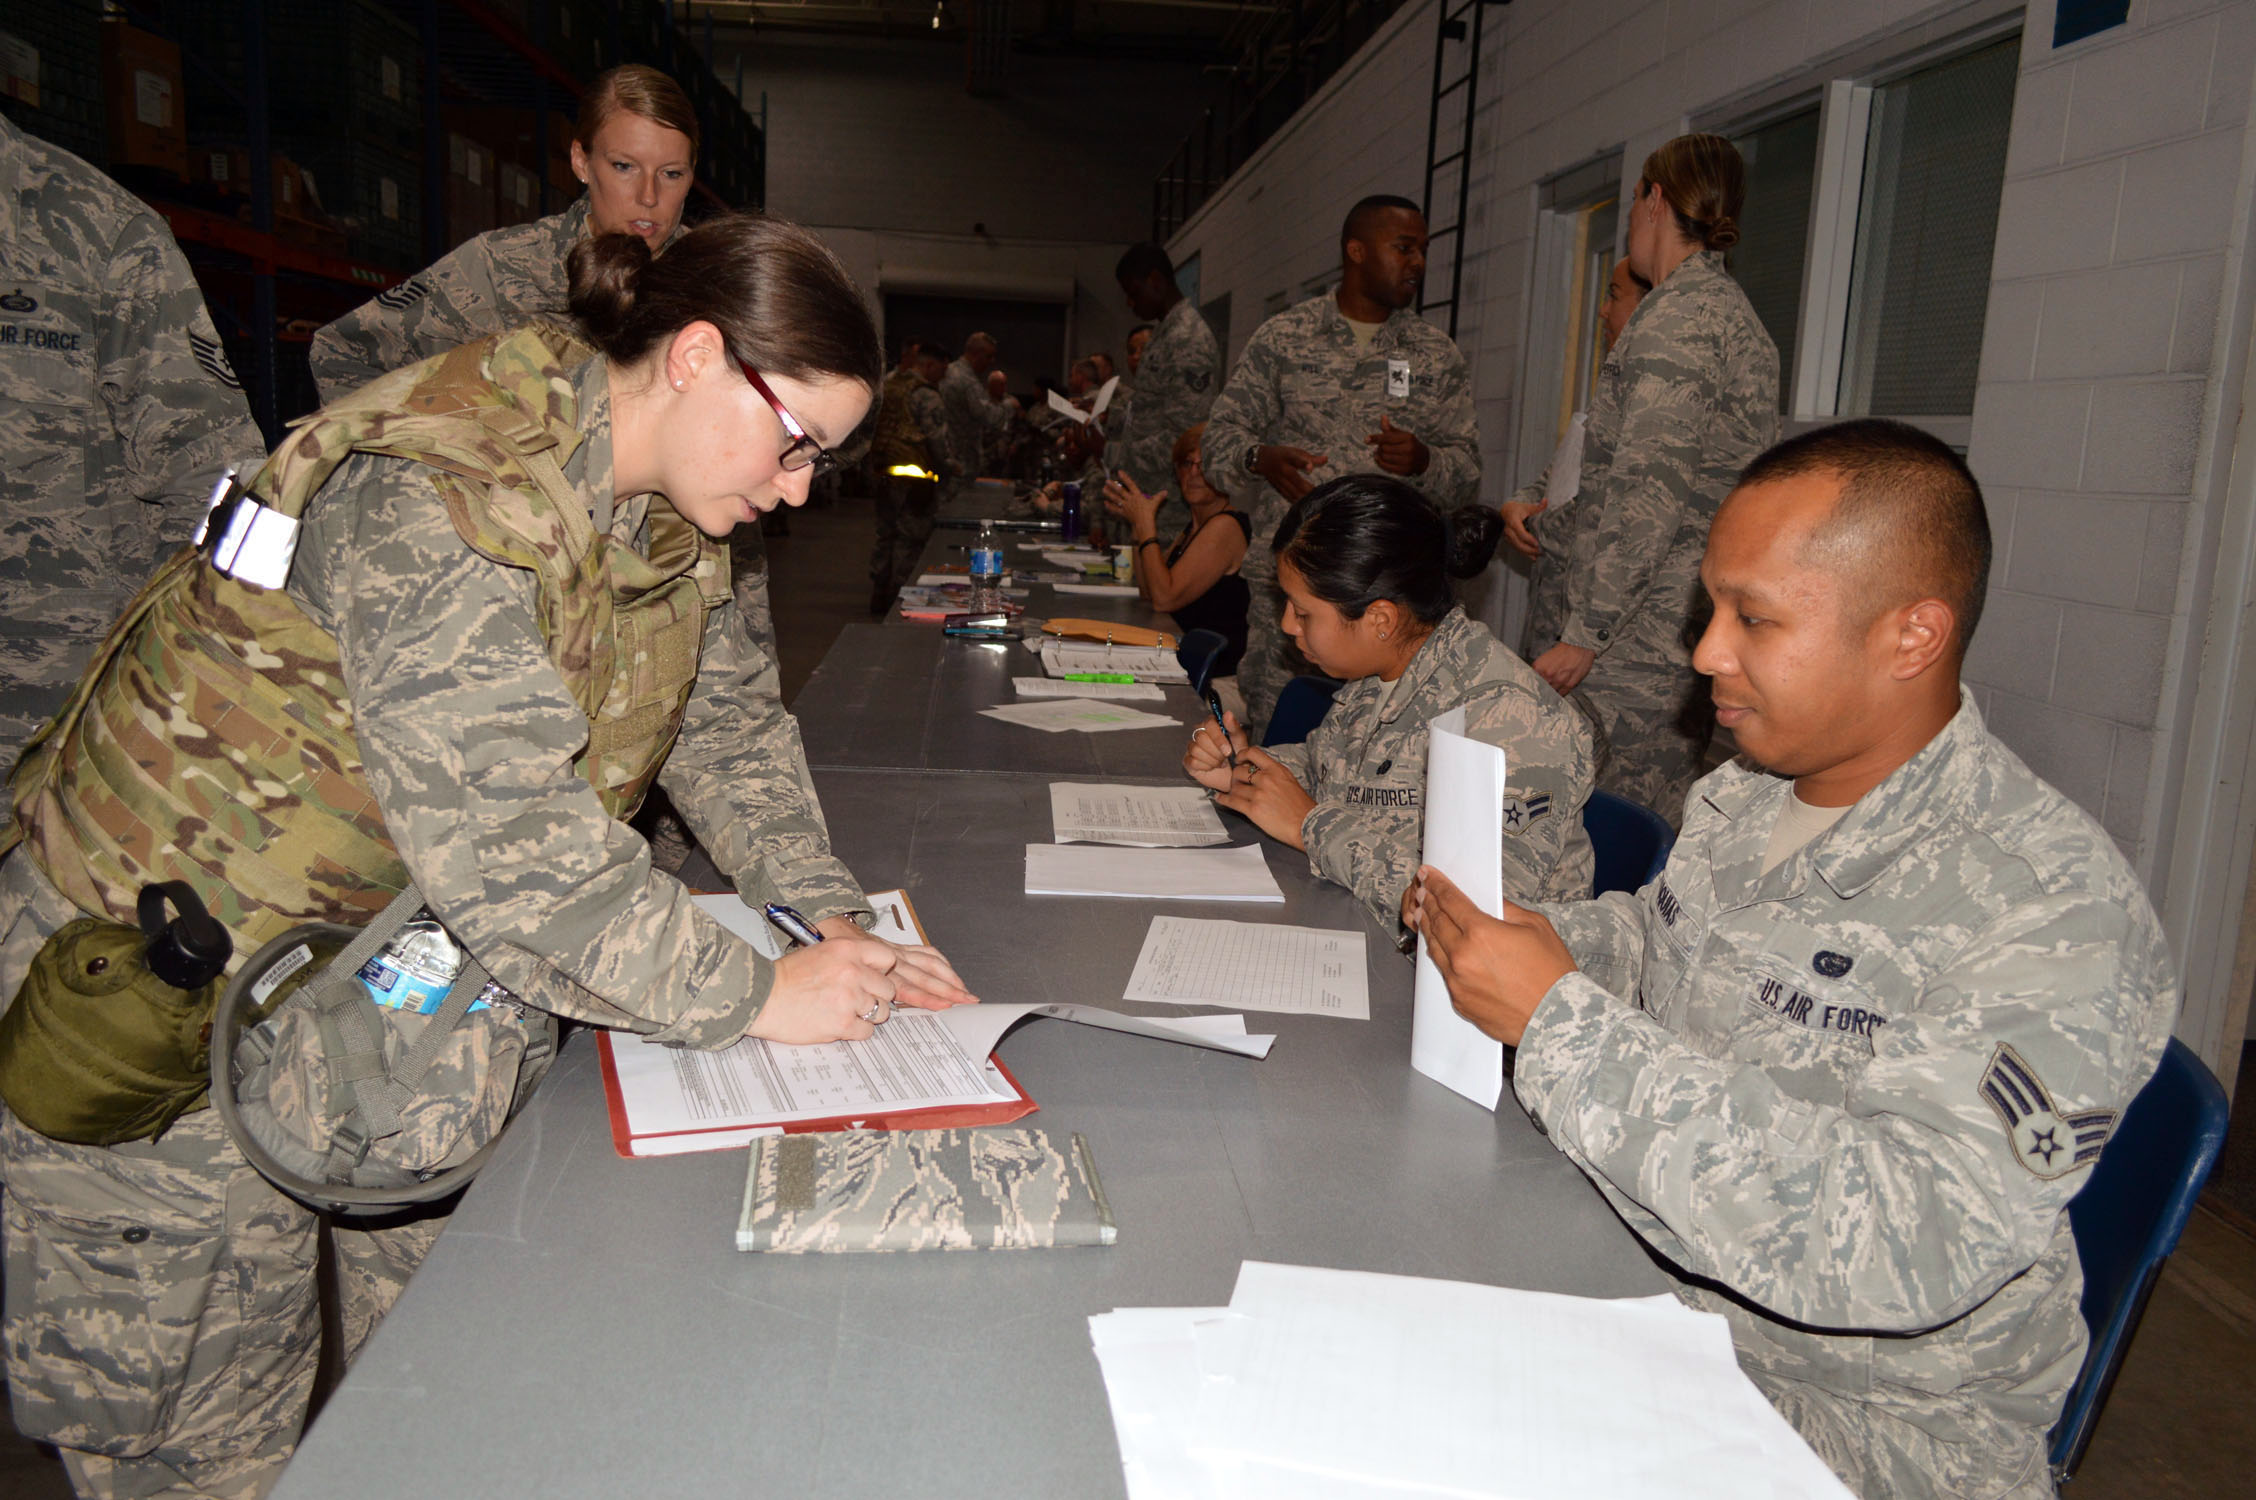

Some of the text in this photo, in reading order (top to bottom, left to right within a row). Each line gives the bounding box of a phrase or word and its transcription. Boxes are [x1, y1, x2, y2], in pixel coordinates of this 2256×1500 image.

[0, 325, 80, 350] IR FORCE
[1360, 787, 1374, 805] AIR
[1375, 788, 1419, 807] FORCE
[1760, 978, 1782, 1010] U.S.
[1782, 992, 1813, 1025] AIR
